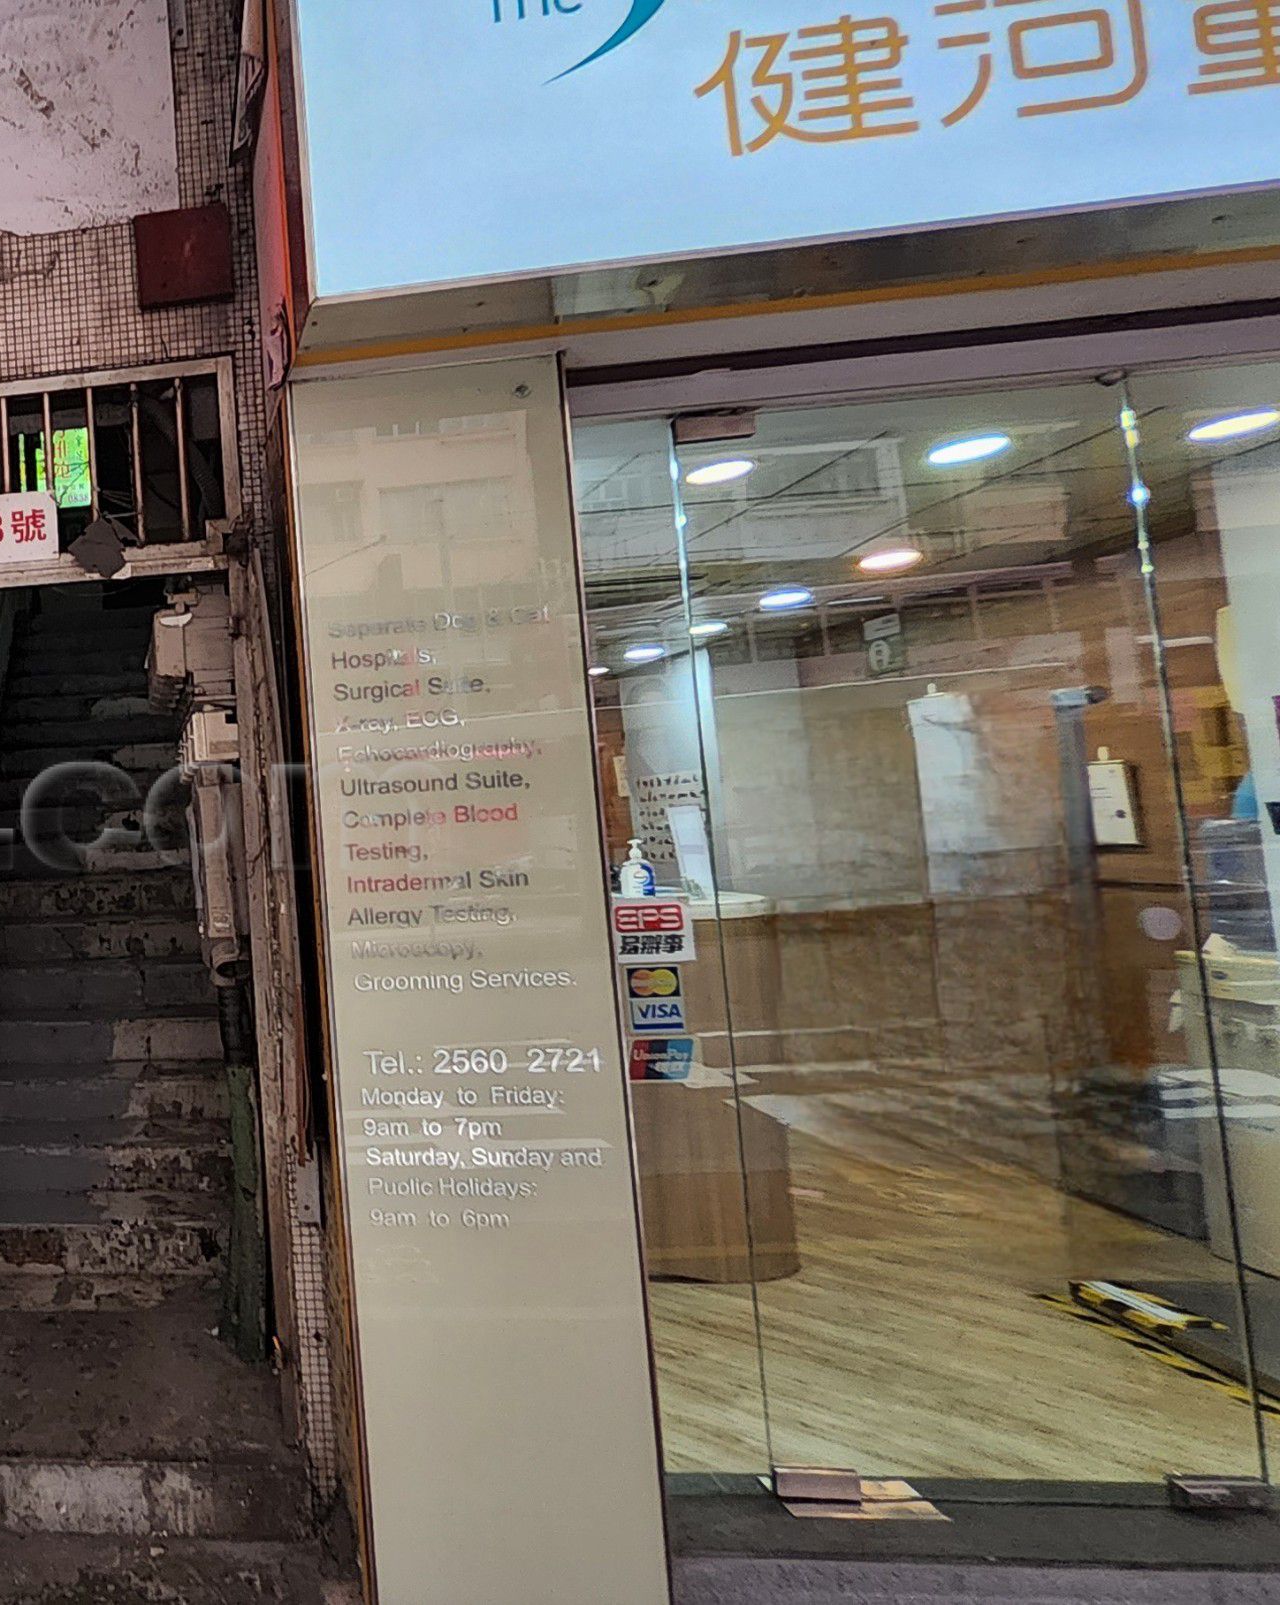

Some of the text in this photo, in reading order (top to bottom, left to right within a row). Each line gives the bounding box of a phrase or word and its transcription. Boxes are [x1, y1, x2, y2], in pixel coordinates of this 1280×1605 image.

[11, 509, 47, 544] 號
[434, 612, 477, 632] Dog
[509, 605, 550, 626] Cat
[333, 678, 420, 703] Surgical
[406, 708, 466, 730] ECG,
[337, 738, 543, 763] Echocardiography,
[340, 769, 530, 798] Ultrasound Suite,
[343, 803, 519, 830] Complete Blood
[346, 842, 428, 863] Testing,
[347, 870, 530, 894] Intradermal Skin
[348, 907, 422, 926] Allergy
[618, 907, 680, 931] EPS
[354, 967, 577, 994] Grooming Services.
[637, 1001, 682, 1020] VISA
[362, 1047, 603, 1075] Tel.: 2560 2721
[361, 1085, 564, 1109] Monday to Friday:
[363, 1117, 502, 1140] 9am to 7pm
[366, 1147, 603, 1171] Saturday, Sunday and
[368, 1177, 538, 1201] Public Holidays:
[370, 1208, 510, 1231] 9am to 6pm
